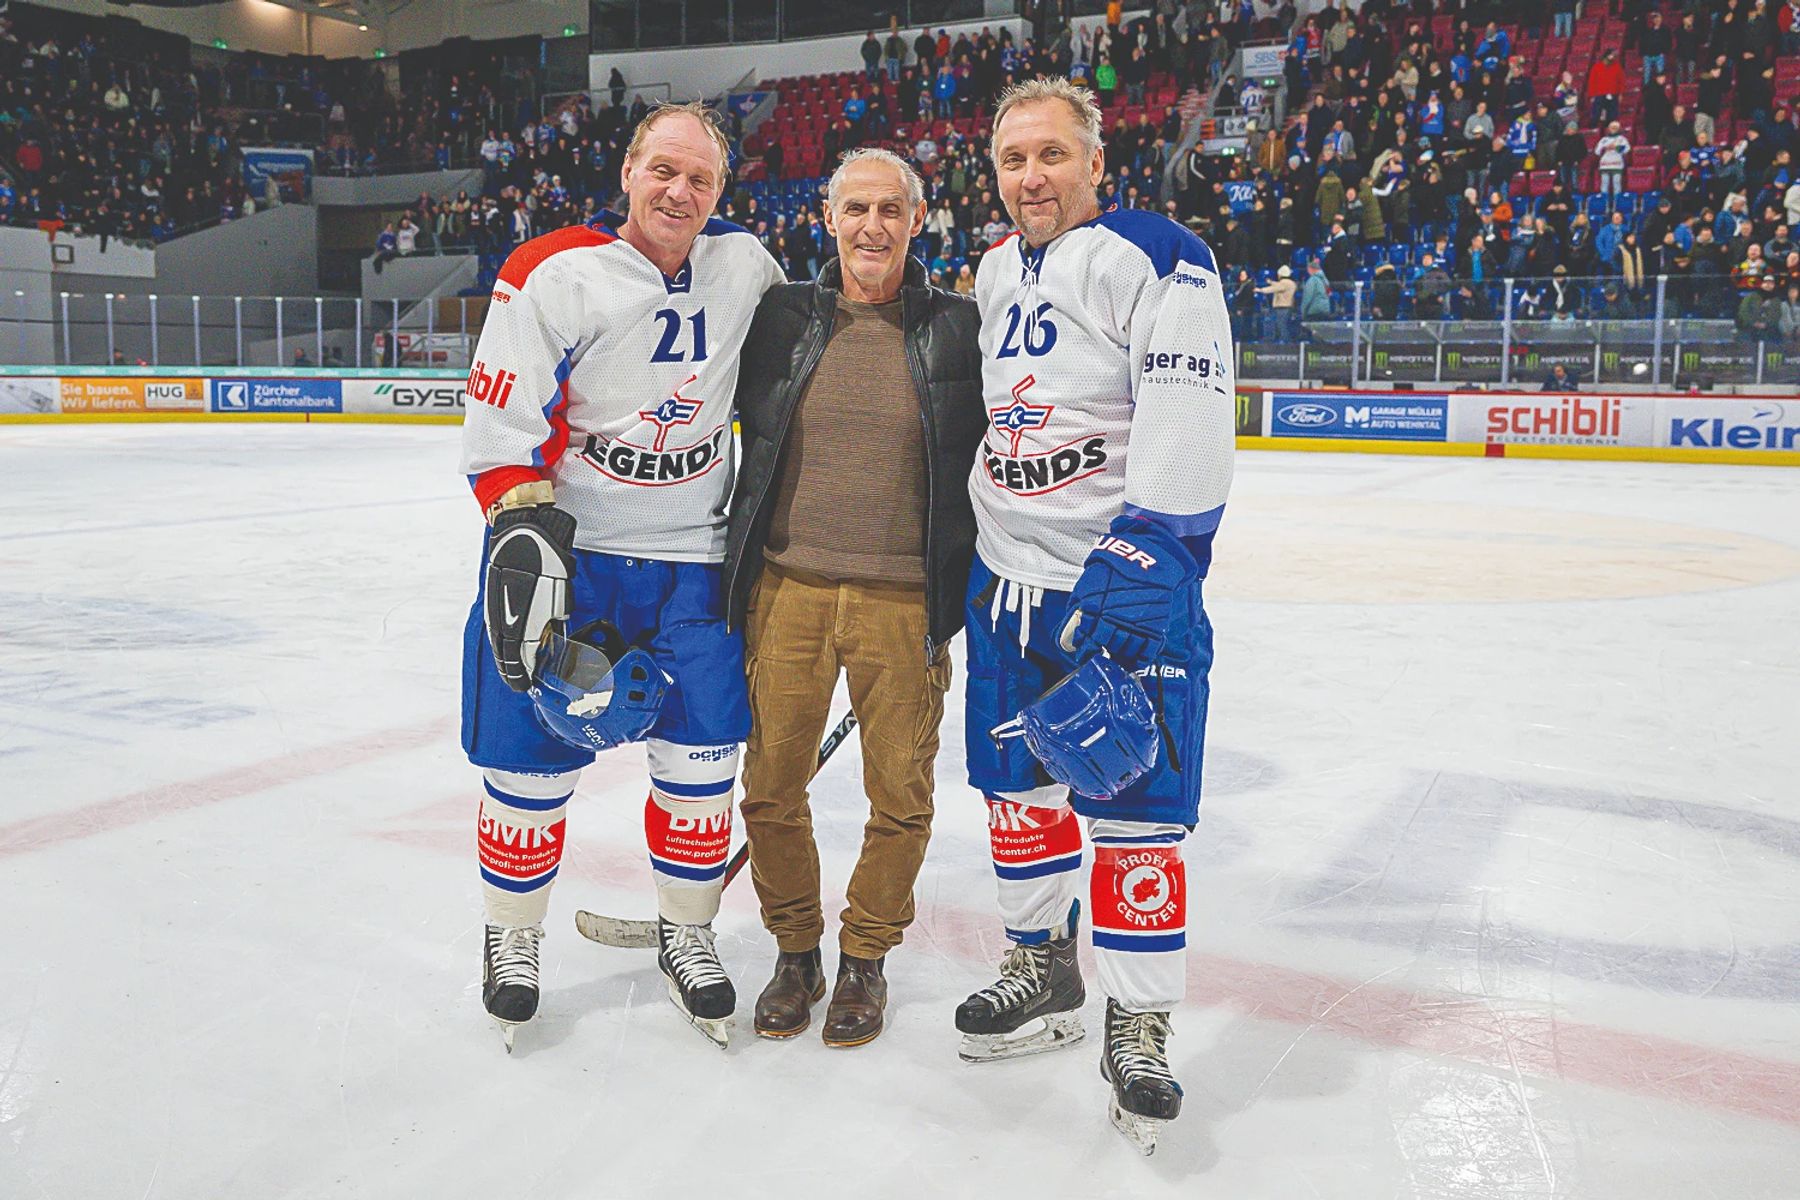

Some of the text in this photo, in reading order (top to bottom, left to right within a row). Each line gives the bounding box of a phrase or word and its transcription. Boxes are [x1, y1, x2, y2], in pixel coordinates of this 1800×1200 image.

[649, 306, 709, 363] 21
[995, 301, 1058, 360] 26
[1187, 355, 1210, 378] ag
[62, 384, 133, 395] Sie bauen.
[147, 386, 183, 398] HUG
[254, 385, 300, 396] Zürcher
[63, 397, 87, 408] Wir
[92, 397, 140, 409] liefern.
[254, 396, 335, 407] Kantonalbank
[1288, 405, 1326, 424] Ford
[1371, 406, 1443, 416] GARAGE MÜLLER
[1370, 420, 1396, 429] AUTO
[1004, 834, 1044, 844] Produkte
[1118, 852, 1168, 871] PROFI
[1117, 900, 1178, 927] CENTER
